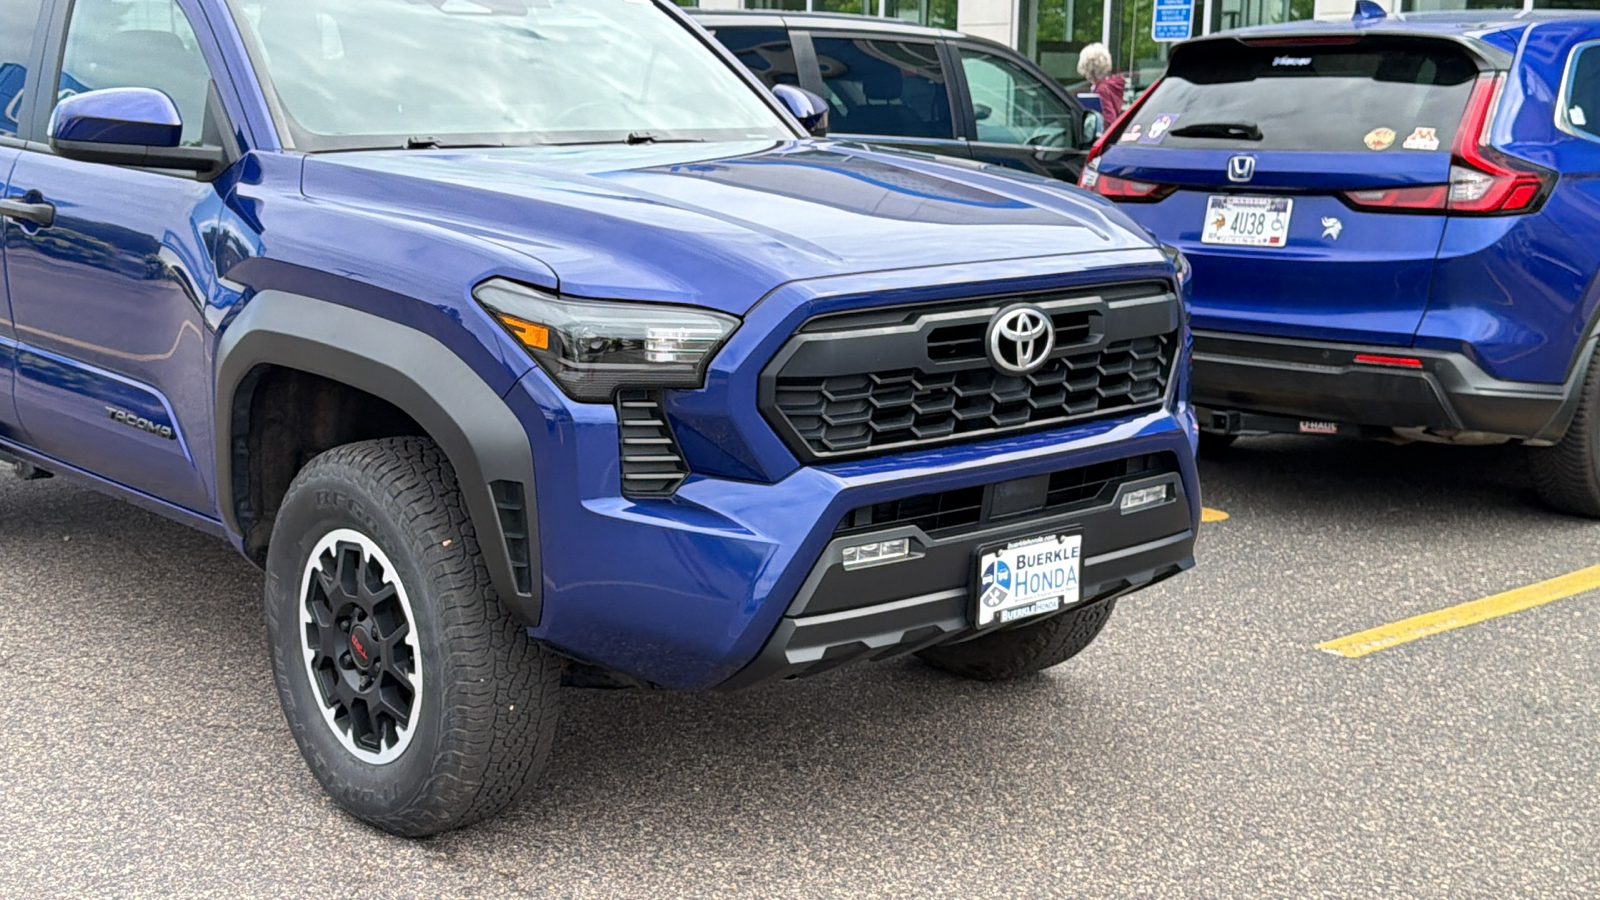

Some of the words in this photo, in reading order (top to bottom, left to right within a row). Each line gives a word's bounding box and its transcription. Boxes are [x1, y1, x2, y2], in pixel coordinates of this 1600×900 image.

[1229, 212, 1266, 235] 4U38
[105, 406, 173, 438] TACOMA
[1015, 565, 1077, 598] HONDA
